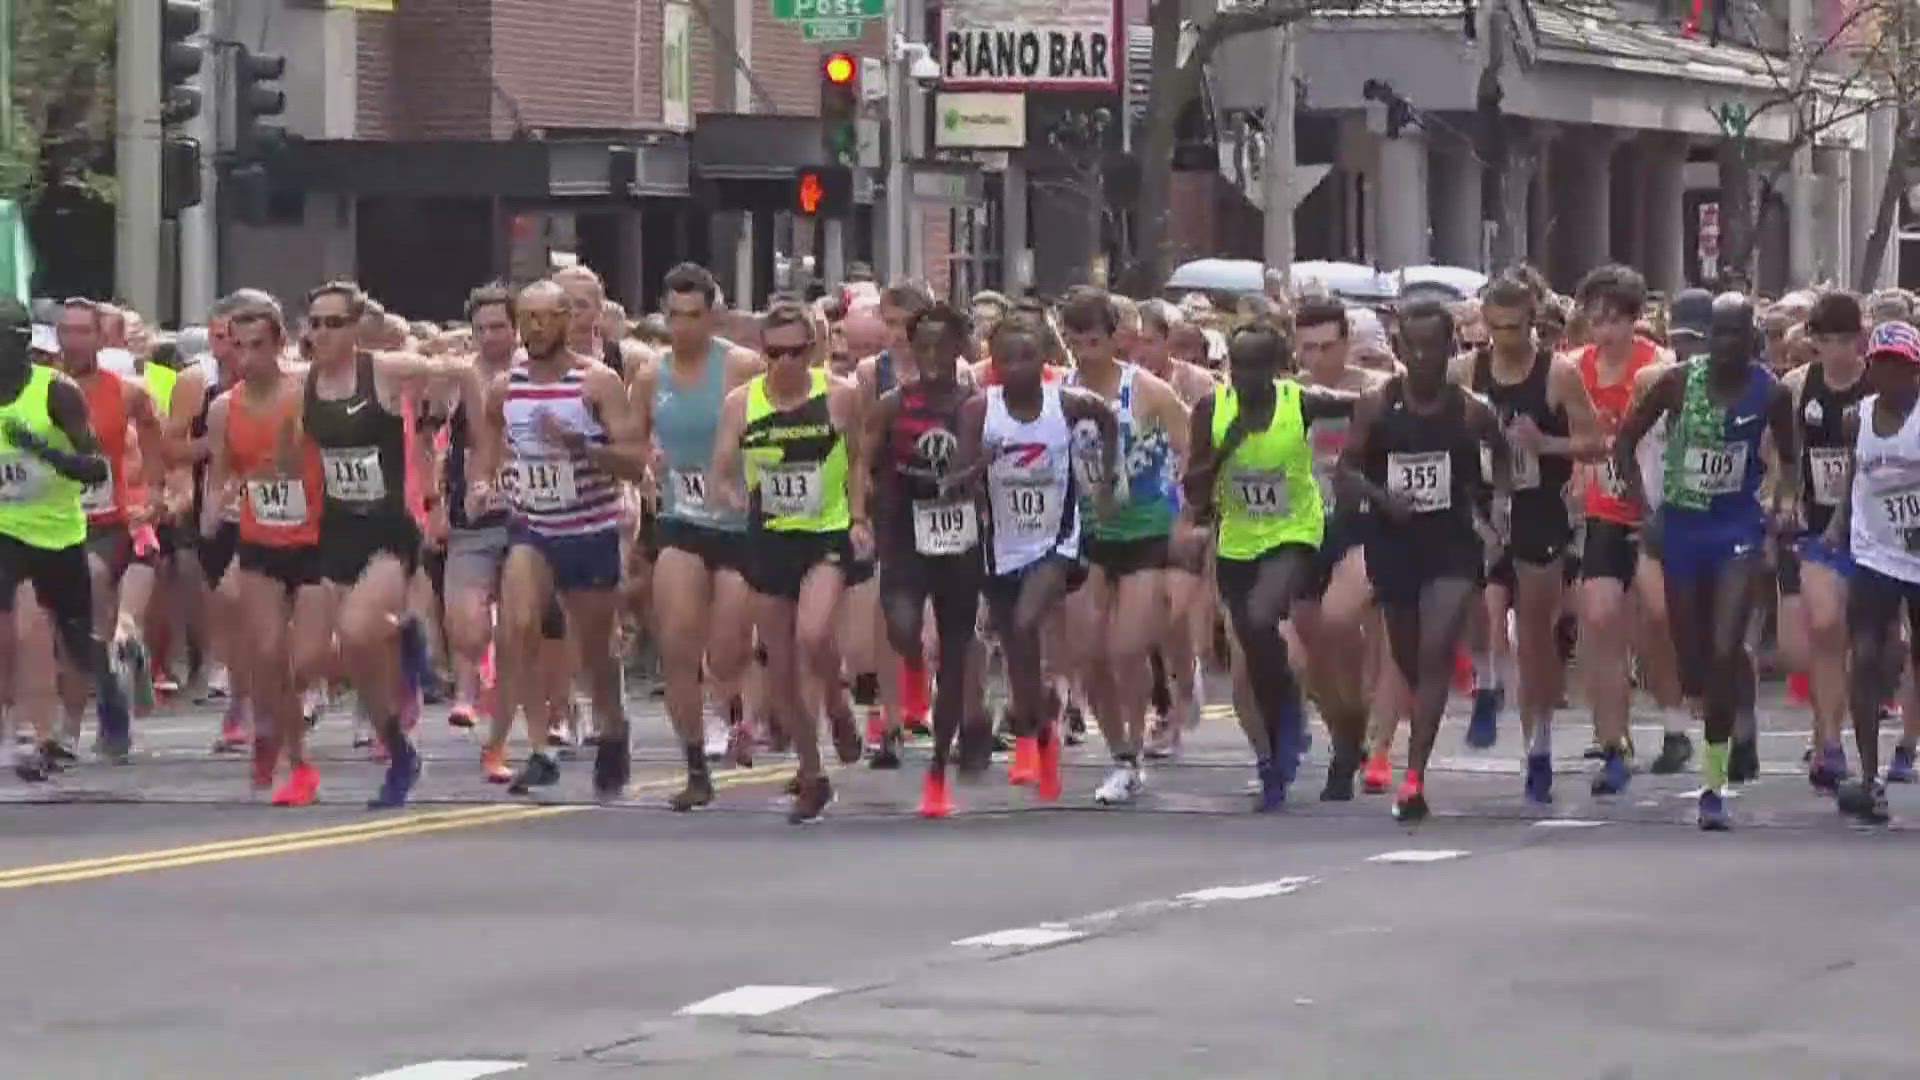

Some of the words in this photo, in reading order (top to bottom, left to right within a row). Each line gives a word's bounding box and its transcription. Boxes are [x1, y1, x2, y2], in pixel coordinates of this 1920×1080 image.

[946, 31, 1040, 77] PIANO
[1048, 31, 1107, 77] BAR
[1700, 452, 1733, 475] 105
[527, 465, 560, 489] 117
[772, 475, 808, 497] 113
[1401, 465, 1438, 491] 355
[1008, 489, 1045, 515] 103
[1241, 486, 1277, 505] 114
[930, 508, 963, 531] 109
